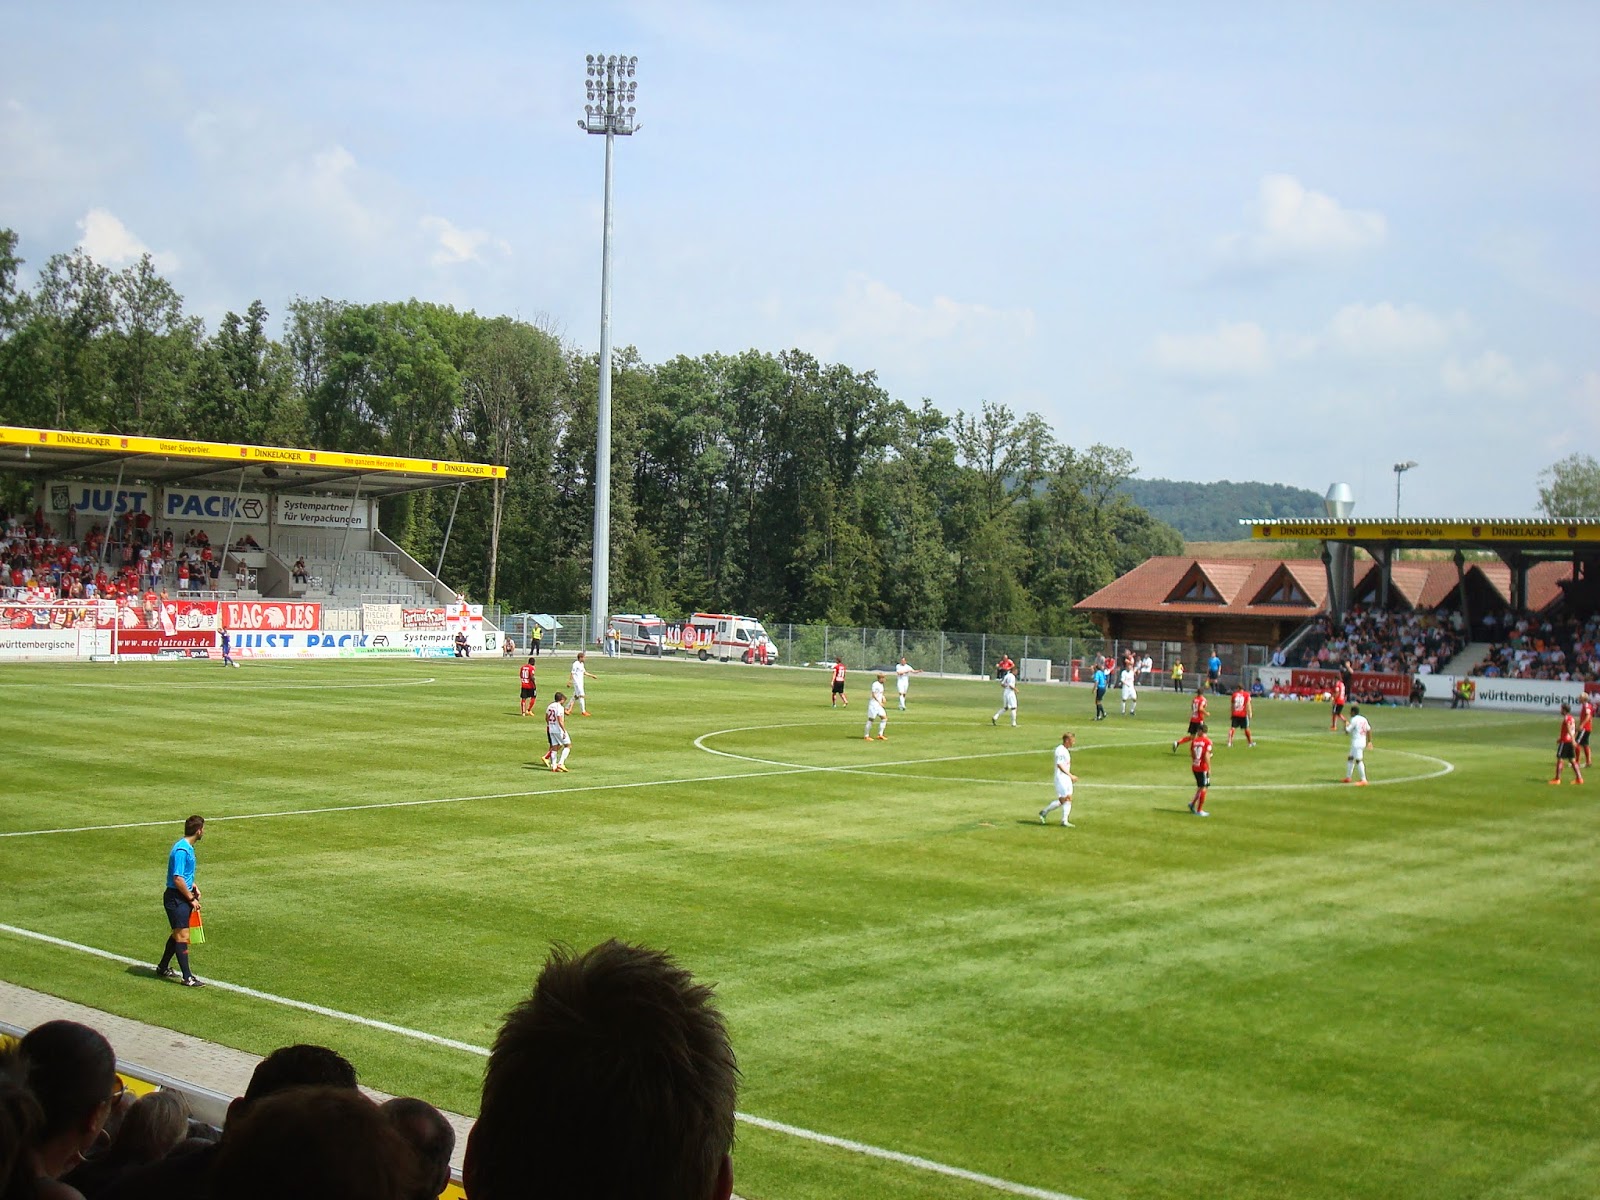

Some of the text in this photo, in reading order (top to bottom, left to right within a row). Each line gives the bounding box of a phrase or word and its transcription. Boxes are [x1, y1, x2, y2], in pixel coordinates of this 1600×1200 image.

[57, 433, 111, 447] DINKELACKER
[160, 443, 211, 454] Unser Siegerbier.
[254, 448, 302, 461] DINKELACKER
[344, 457, 354, 466] Von
[355, 459, 375, 468] ganzem
[376, 460, 394, 468] Herzen
[444, 463, 484, 474] DINKELACKER
[75, 488, 148, 513] JUST
[167, 494, 241, 518] PACK
[284, 500, 349, 512] Systempartner
[284, 512, 362, 525] für Verpackungen
[1280, 526, 1337, 537] DINKELACKER
[1382, 528, 1403, 536] Immer
[1492, 526, 1556, 537] DINKELACKER
[117, 637, 210, 647] www.mechatronik.de
[404, 633, 469, 642] Systempartr
[0, 640, 75, 651] württembergische
[1298, 674, 1316, 685] The
[1353, 675, 1365, 688] of
